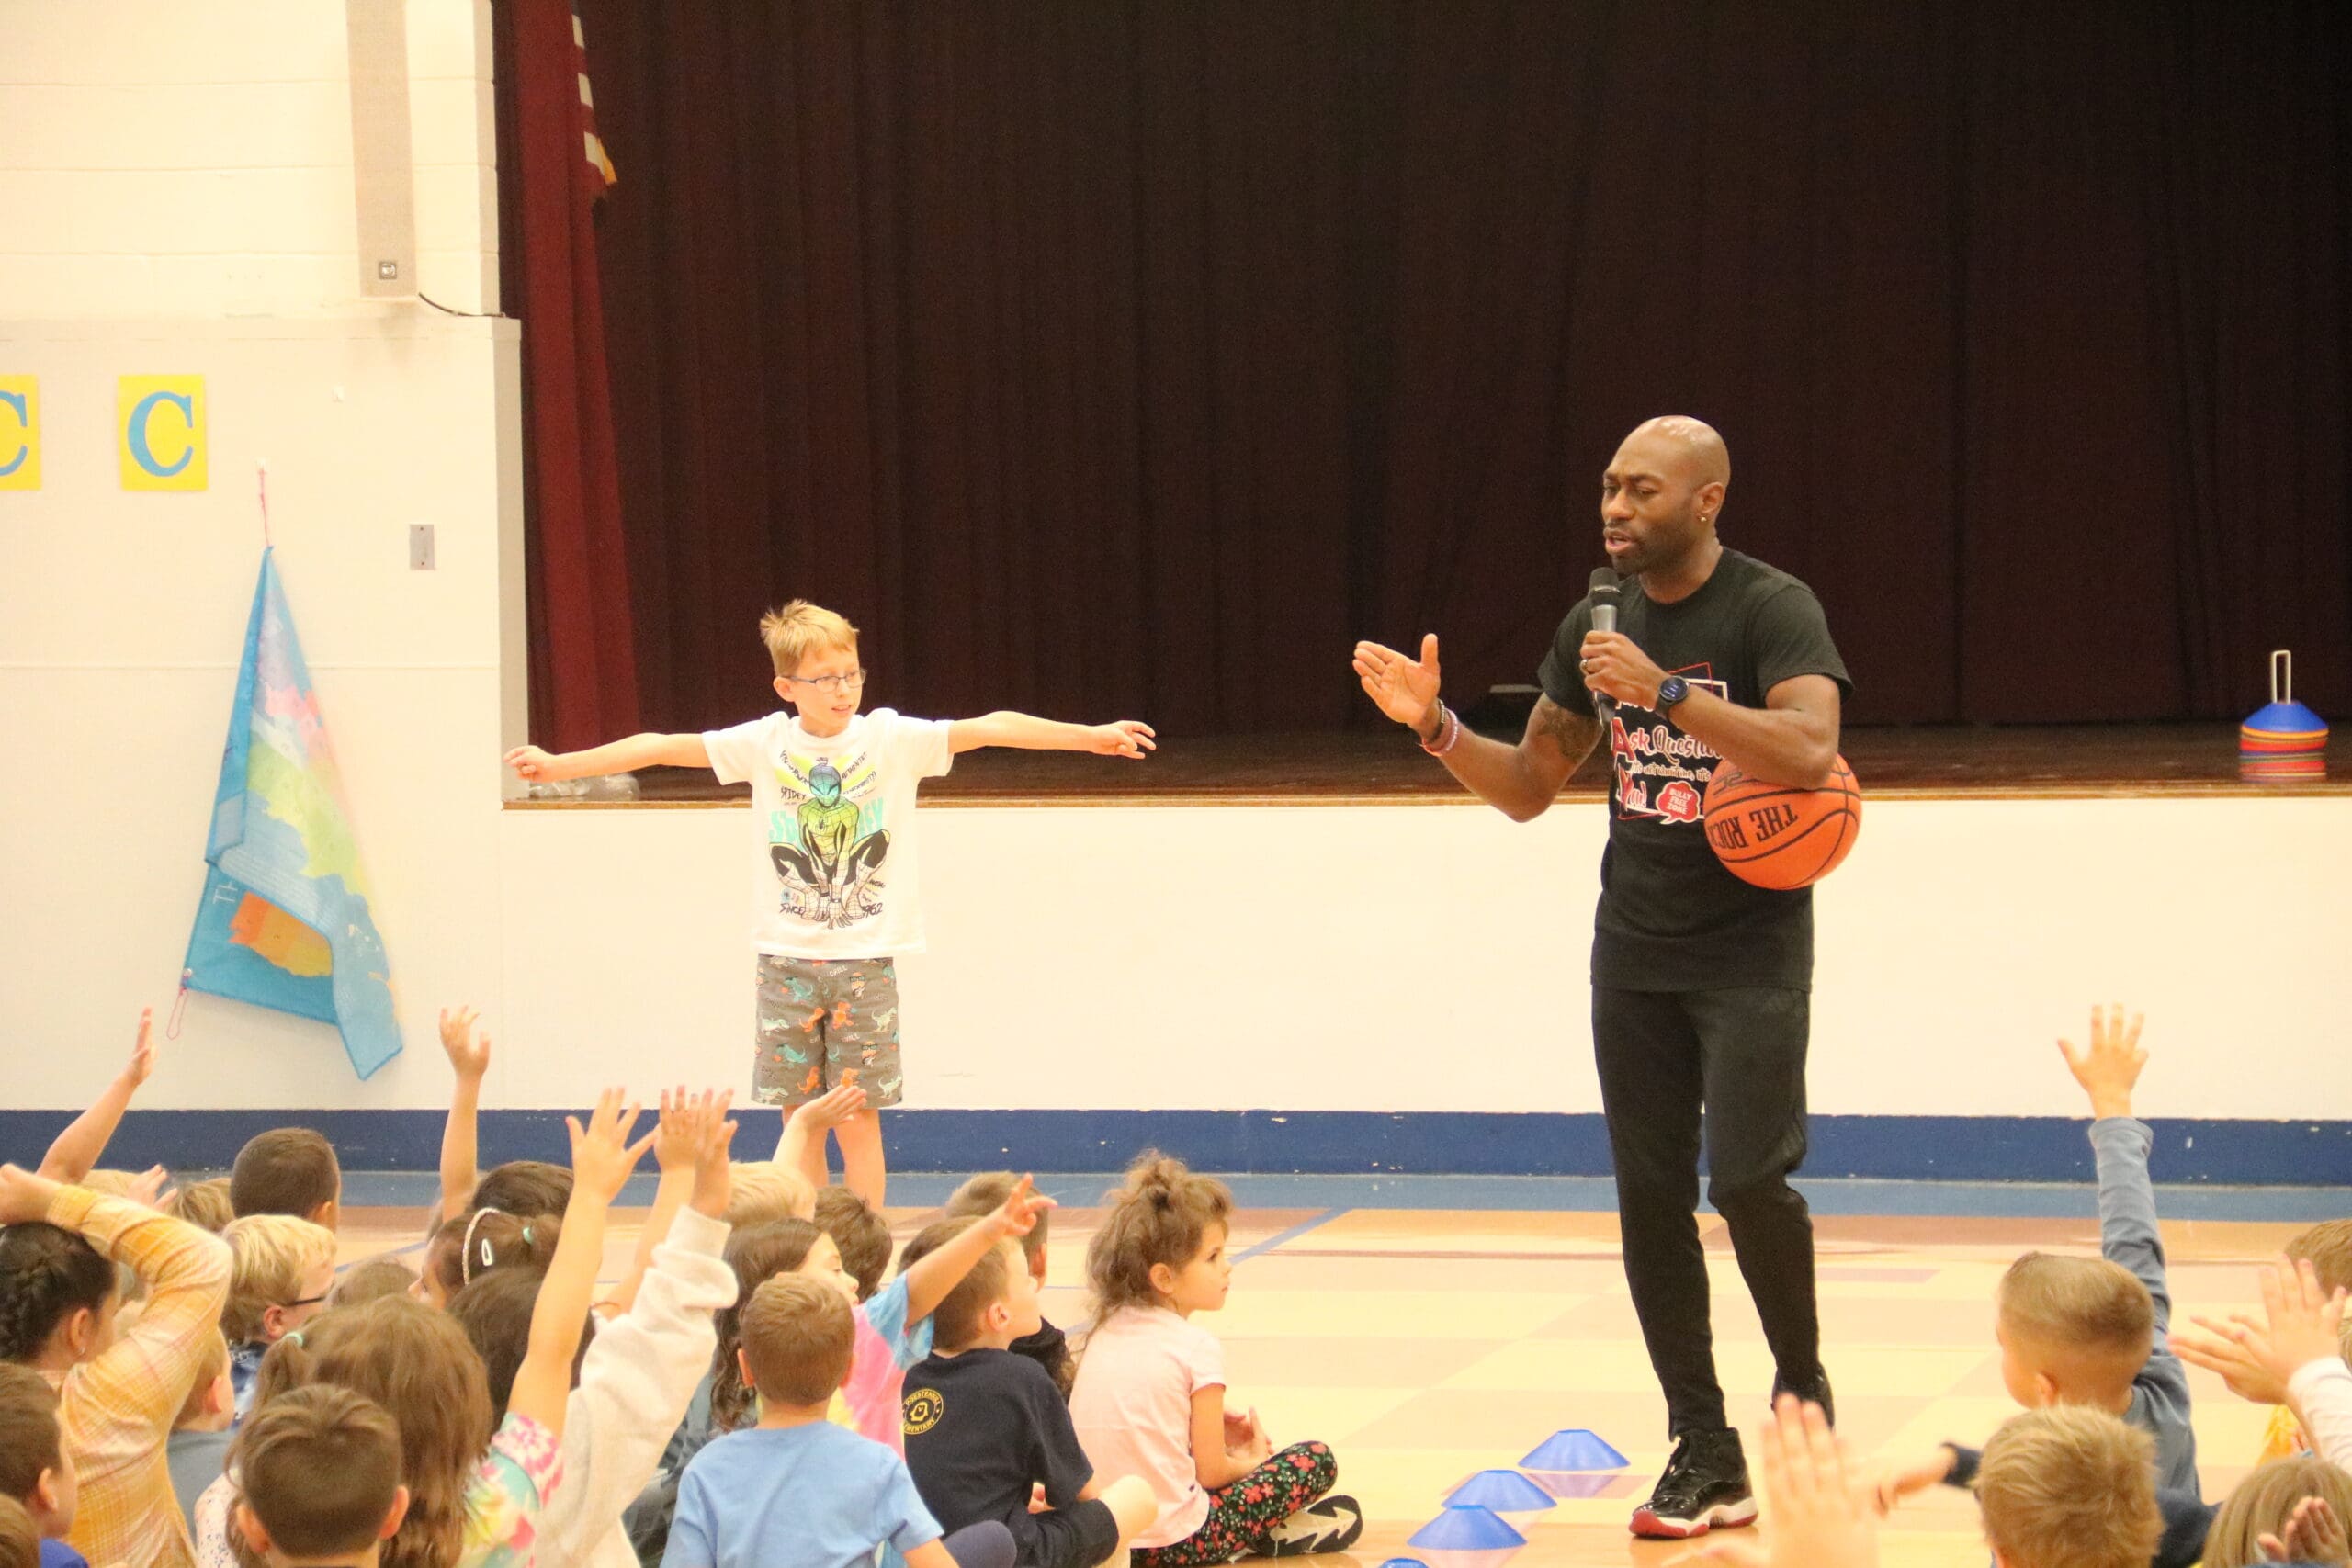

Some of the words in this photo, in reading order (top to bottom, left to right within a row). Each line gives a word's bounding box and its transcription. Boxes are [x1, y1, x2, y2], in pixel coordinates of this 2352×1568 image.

[127, 390, 194, 477] C
[1611, 717, 1656, 768] Ask
[1668, 795, 1688, 807] FREE
[1669, 788, 1692, 800] BULLY
[1667, 802, 1688, 815] ZONE
[1748, 804, 1799, 842] THE
